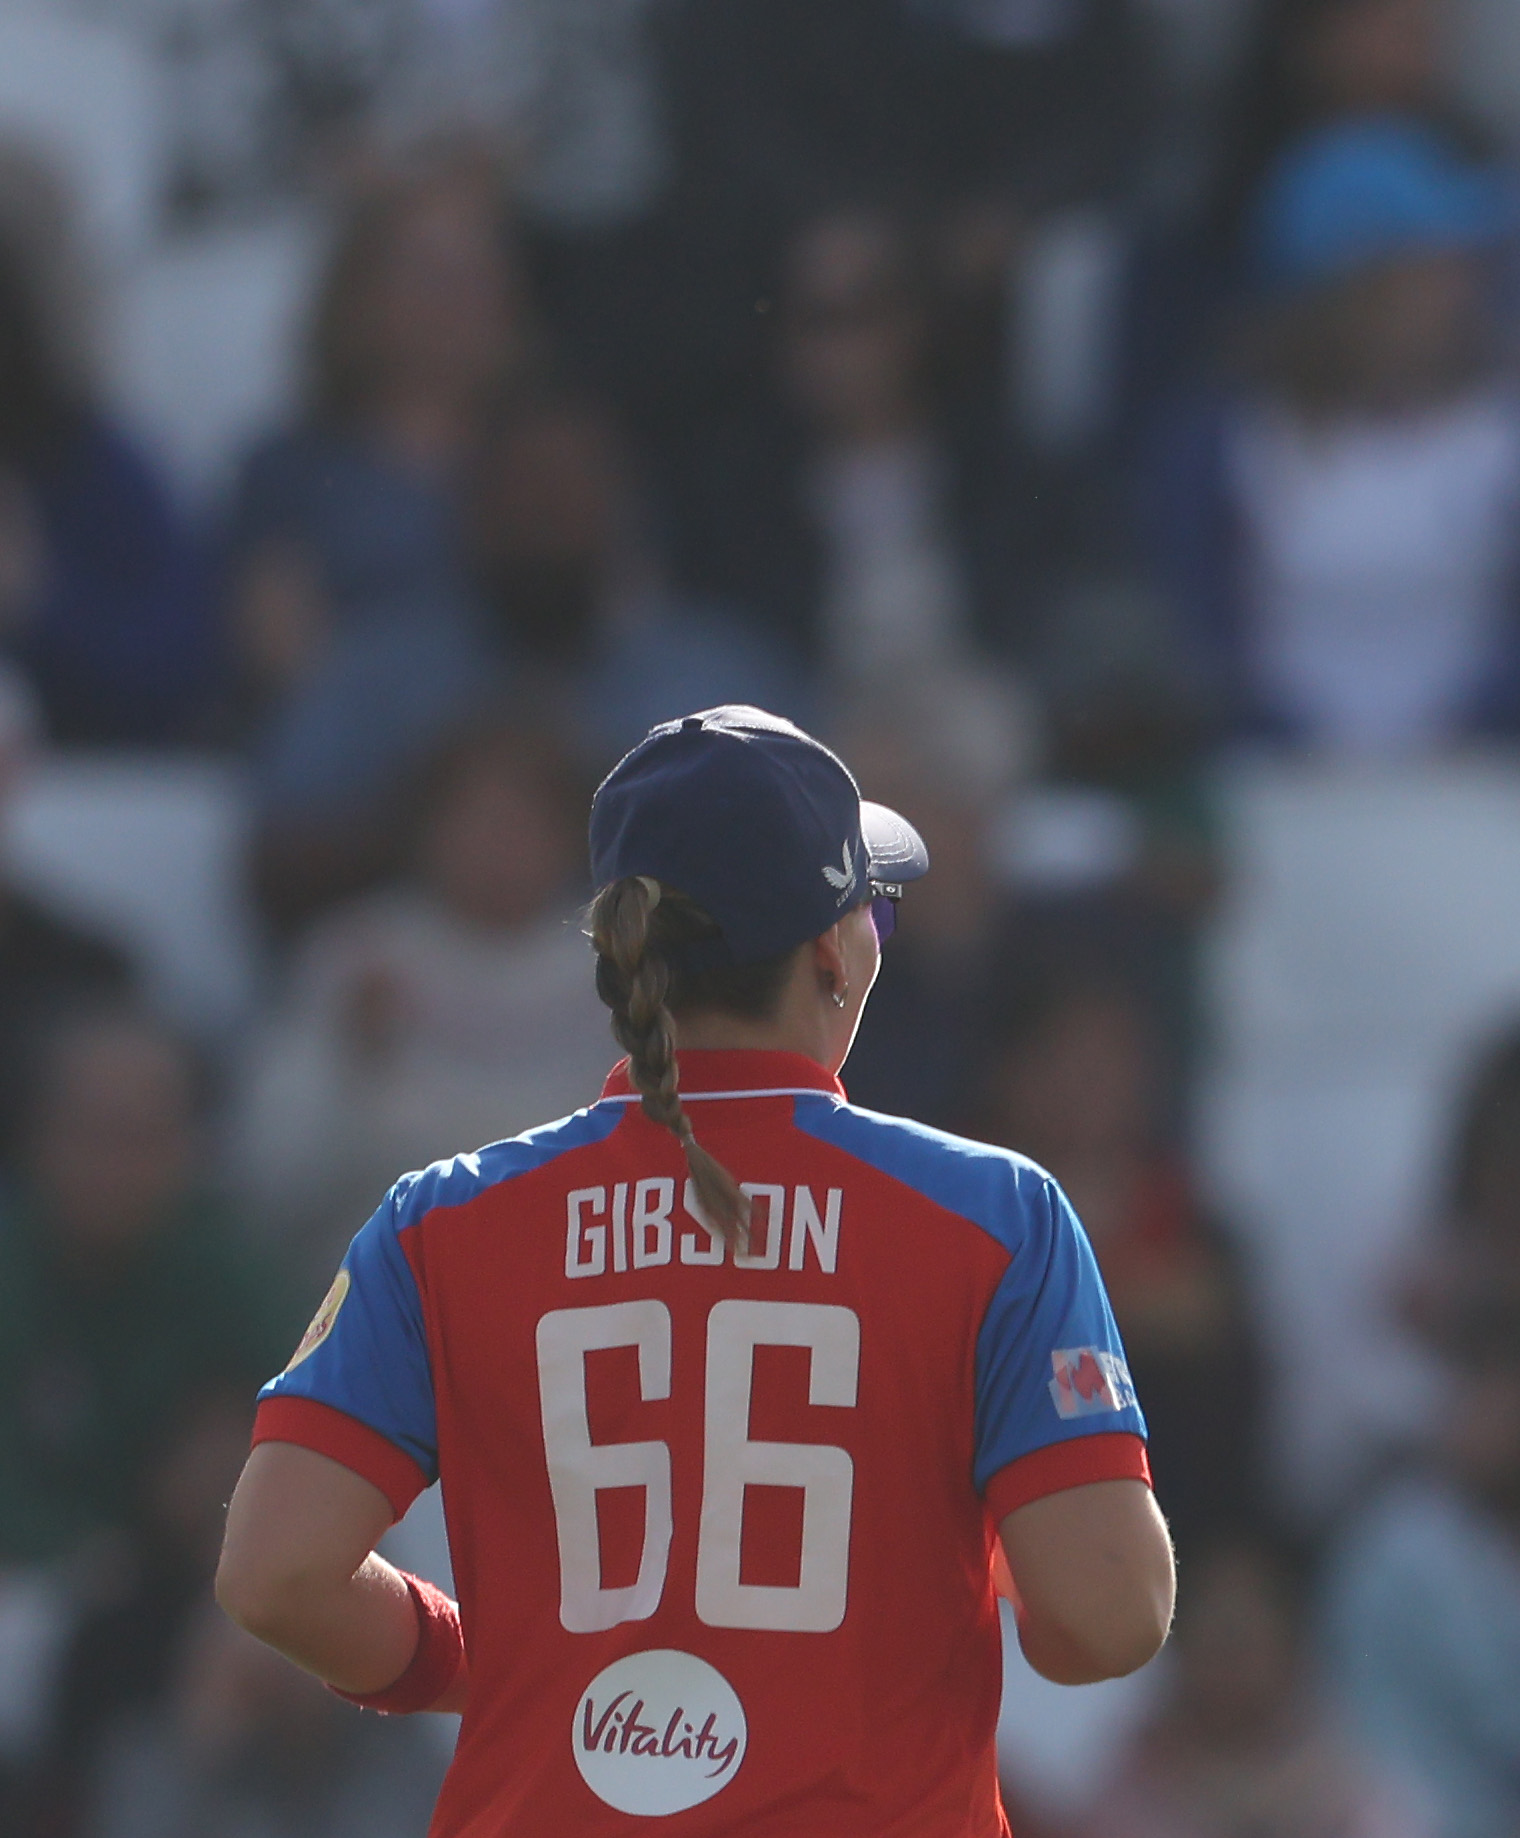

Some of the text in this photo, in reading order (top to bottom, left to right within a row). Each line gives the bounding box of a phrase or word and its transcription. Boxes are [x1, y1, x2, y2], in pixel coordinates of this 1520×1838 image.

[565, 1177, 843, 1279] GIBSON
[537, 1299, 861, 1634] 66
[583, 1690, 739, 1778] Vitality
